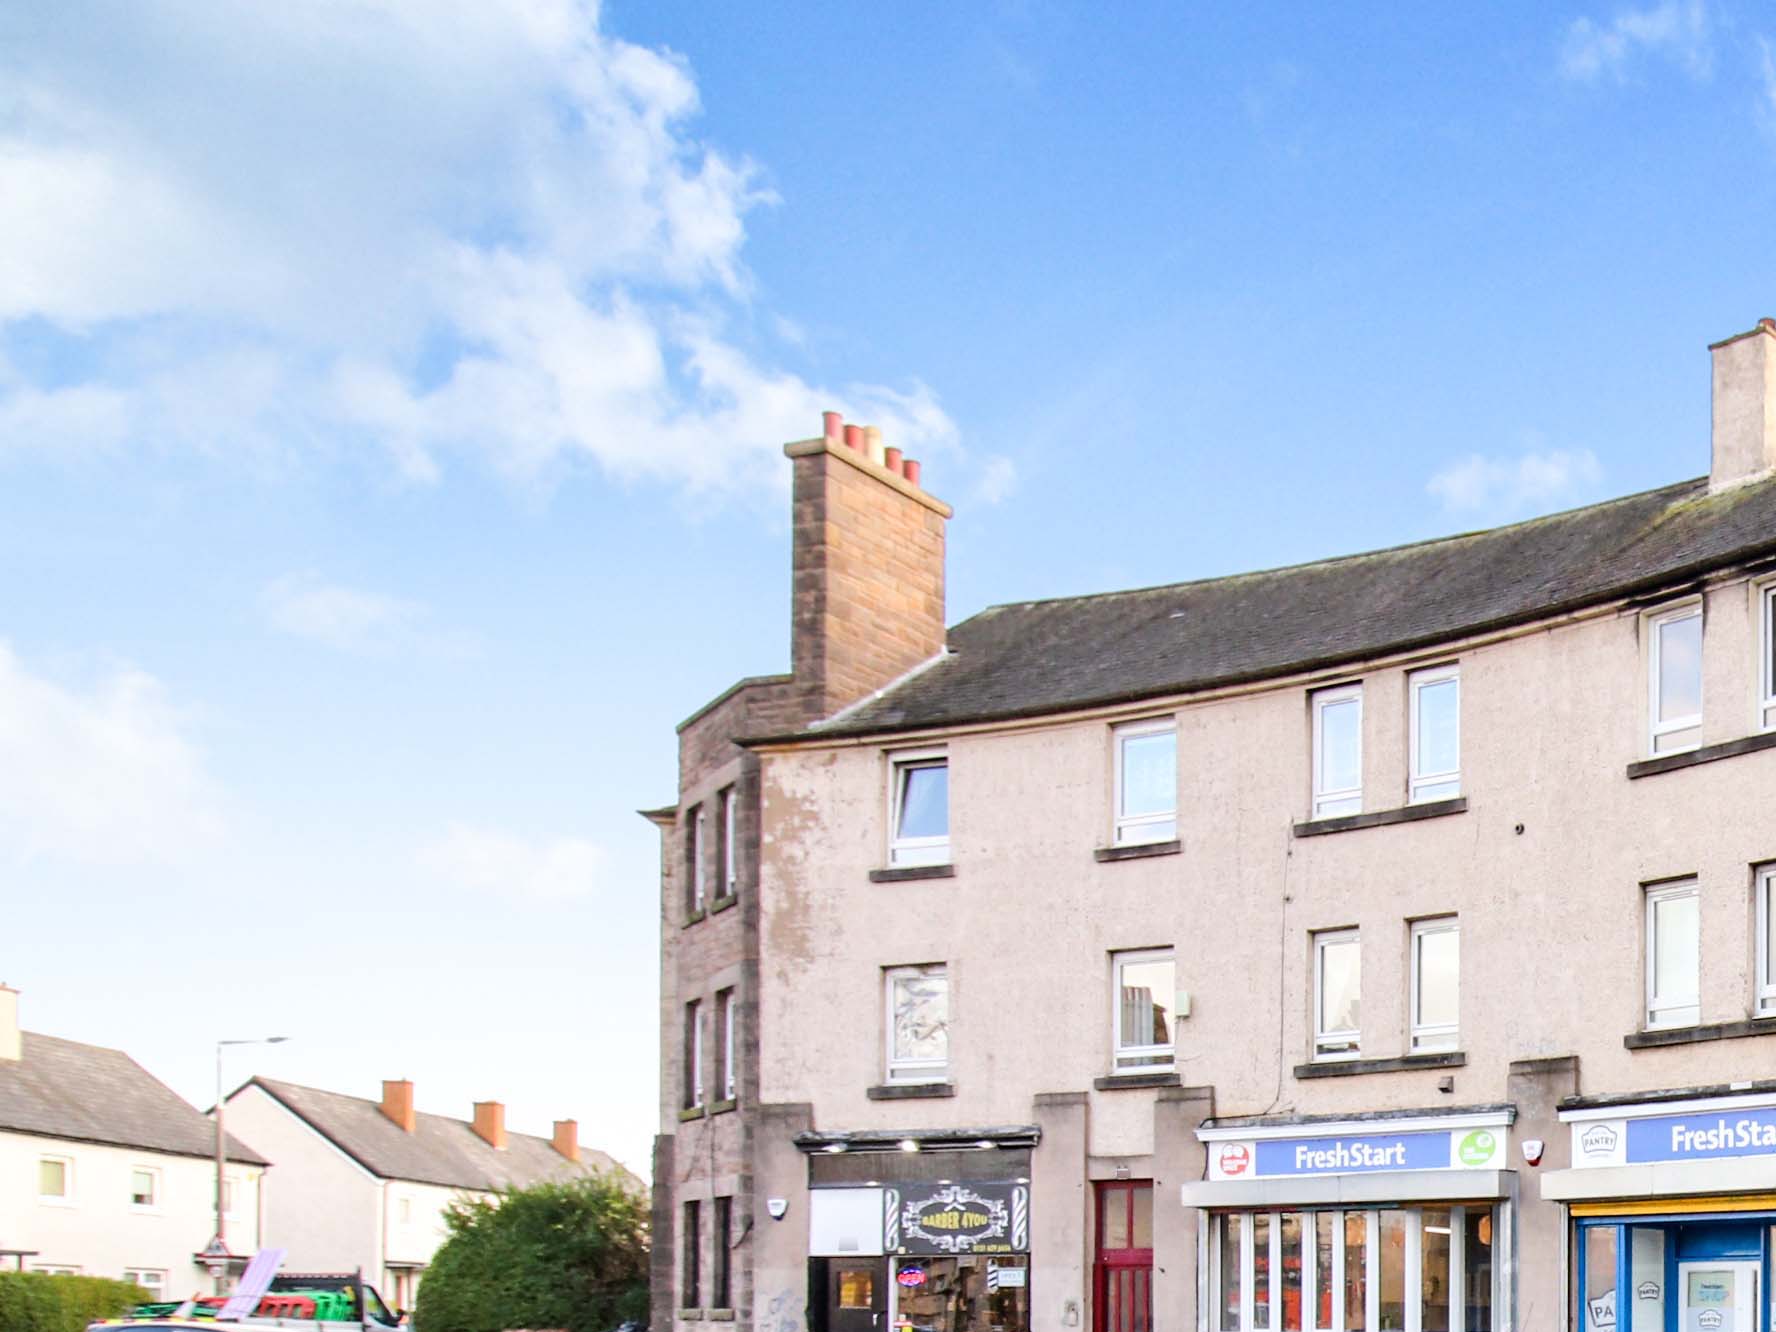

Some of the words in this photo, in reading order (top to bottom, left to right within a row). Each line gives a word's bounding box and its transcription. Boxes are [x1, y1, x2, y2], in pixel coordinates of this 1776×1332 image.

[1584, 1136, 1614, 1147] PANTRY
[1295, 1141, 1406, 1169] FreshStart
[922, 1211, 959, 1229] BARBER
